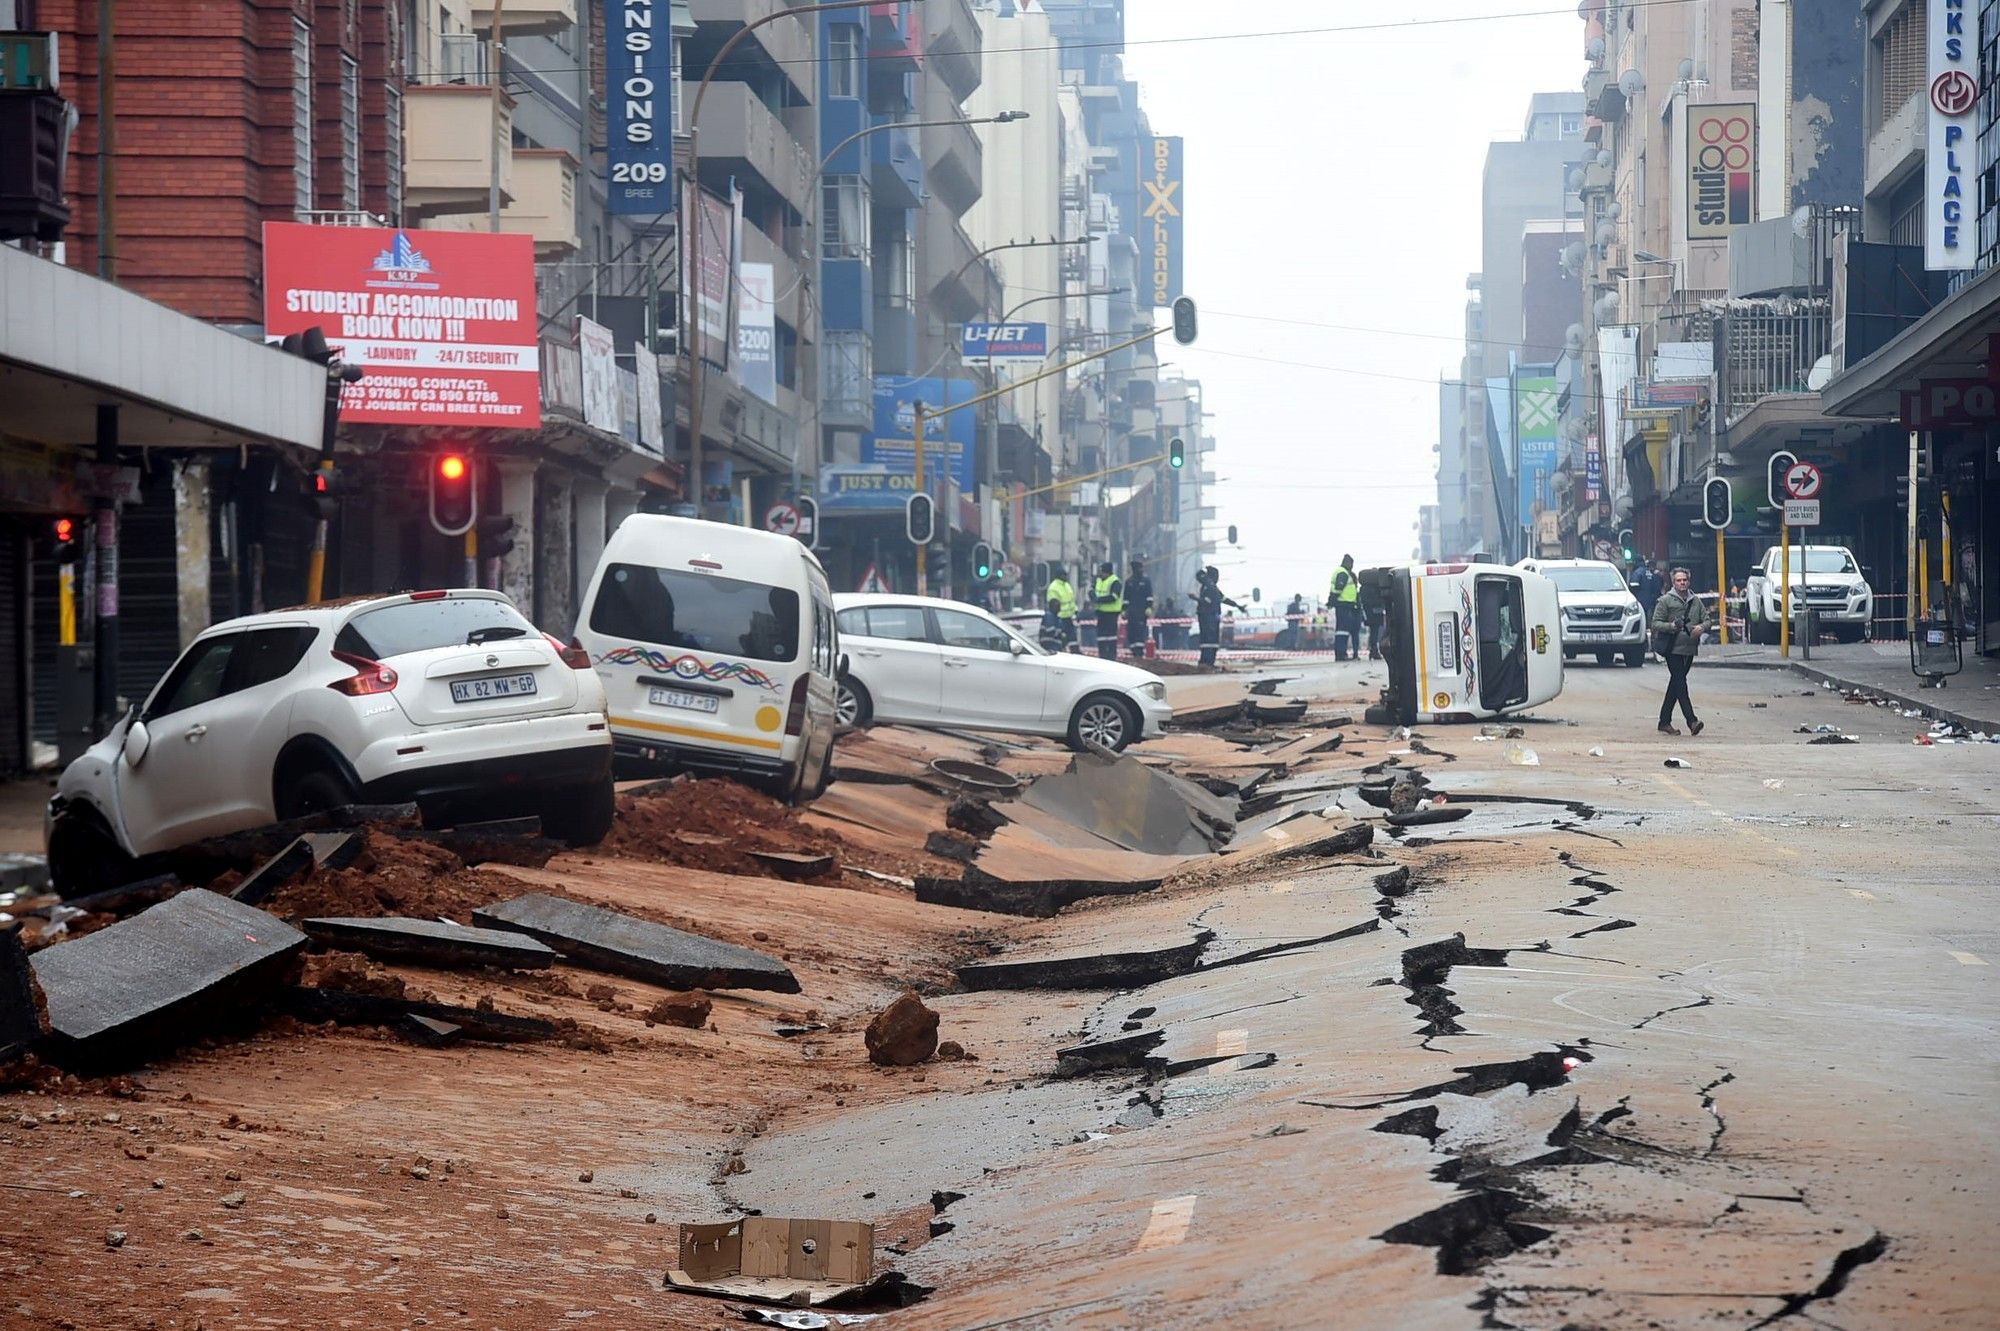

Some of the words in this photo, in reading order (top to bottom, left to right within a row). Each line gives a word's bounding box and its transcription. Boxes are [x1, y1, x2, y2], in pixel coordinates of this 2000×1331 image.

[612, 162, 667, 183] 209
[625, 188, 654, 198] BREE
[1692, 145, 1726, 226] studio
[1943, 125, 1963, 248] PLACE
[1143, 139, 1180, 305] BetXchange
[286, 289, 371, 315] STUDENT
[372, 293, 518, 321] ACCOMODATION
[342, 315, 395, 339] BOOK
[397, 317, 442, 341] NOW
[446, 319, 465, 341] !!!
[466, 351, 519, 366] SECURITY
[421, 377, 488, 390] CONTACT:
[348, 400, 364, 410] 72
[364, 400, 417, 412] JOUBERT
[447, 403, 477, 414] BREE
[479, 404, 523, 415] STREET
[1522, 441, 1555, 451] LISTER
[839, 475, 884, 492] JUST
[888, 475, 916, 490] ON
[1785, 505, 1802, 513] EXCEPT
[454, 684, 469, 700] HX
[475, 681, 490, 696] 82
[494, 679, 510, 695] MW
[518, 677, 533, 692] GP
